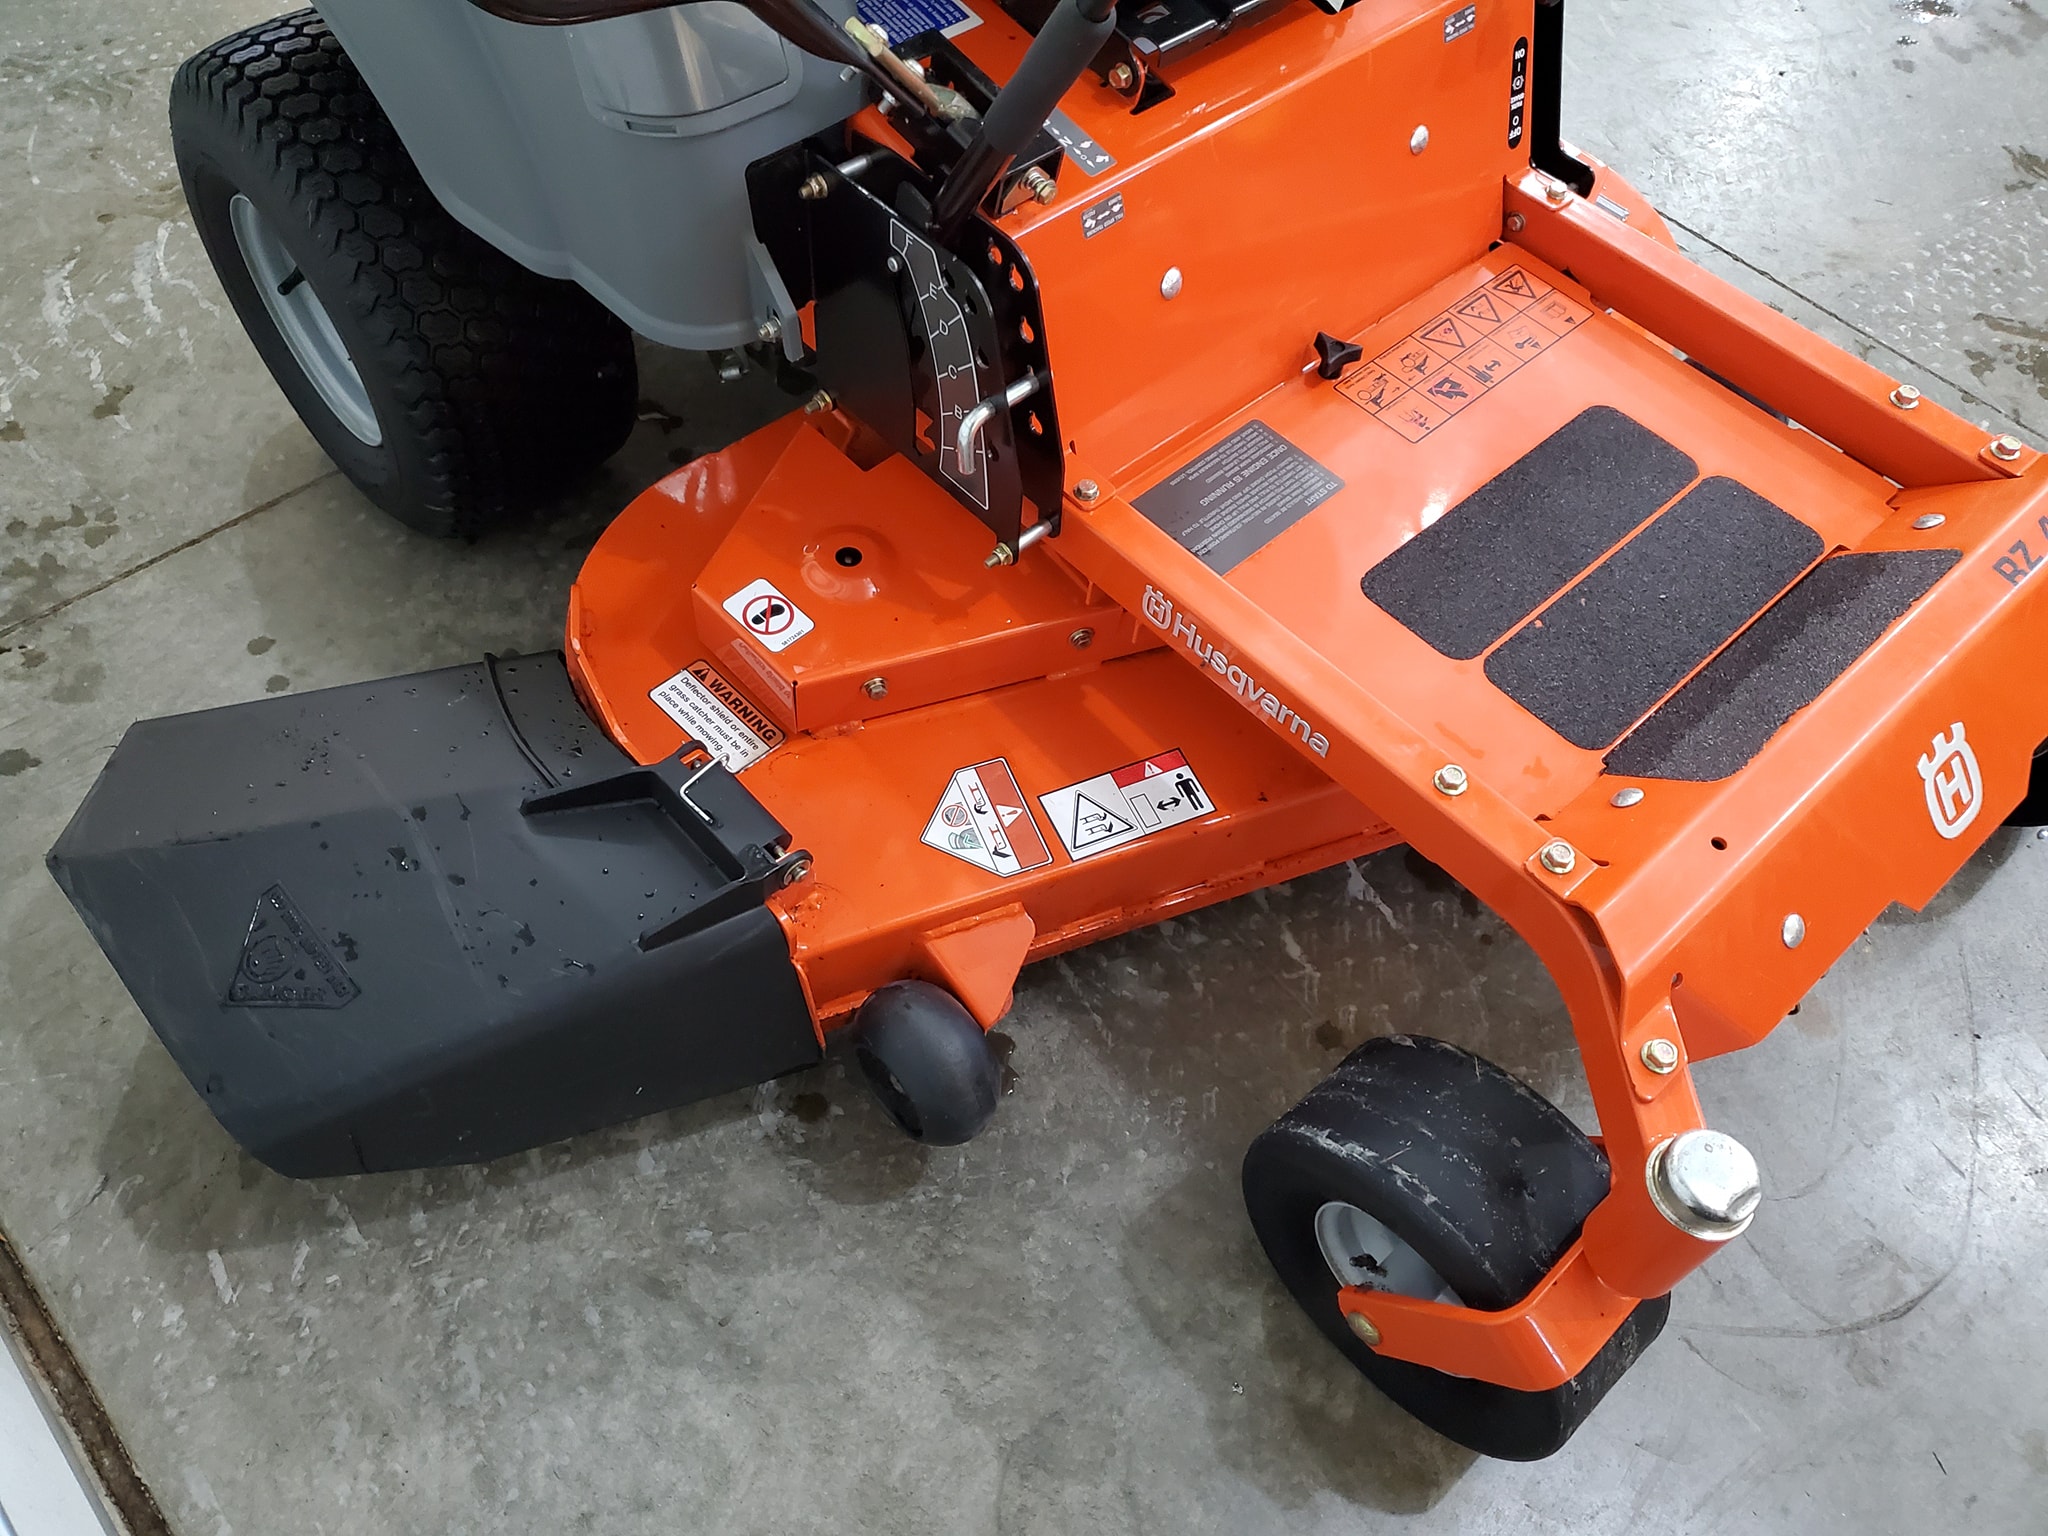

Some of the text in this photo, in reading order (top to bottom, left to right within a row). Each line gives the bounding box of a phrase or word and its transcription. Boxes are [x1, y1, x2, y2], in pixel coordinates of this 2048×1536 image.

[1508, 126, 1522, 139] OFF
[929, 282, 938, 300] E
[939, 319, 948, 336] D
[948, 364, 958, 380] C
[954, 404, 962, 420] B
[1198, 444, 1288, 506] ONCE ENGINE IS RUNNING
[1302, 487, 1328, 506] START
[1992, 540, 2044, 586] RZ
[1172, 612, 1330, 758] Husqvarna
[658, 690, 722, 753] place while mowing.
[668, 684, 749, 758] grass catcher must be in
[680, 676, 760, 751] Deflector shield or entire
[709, 678, 777, 742] WARNING
